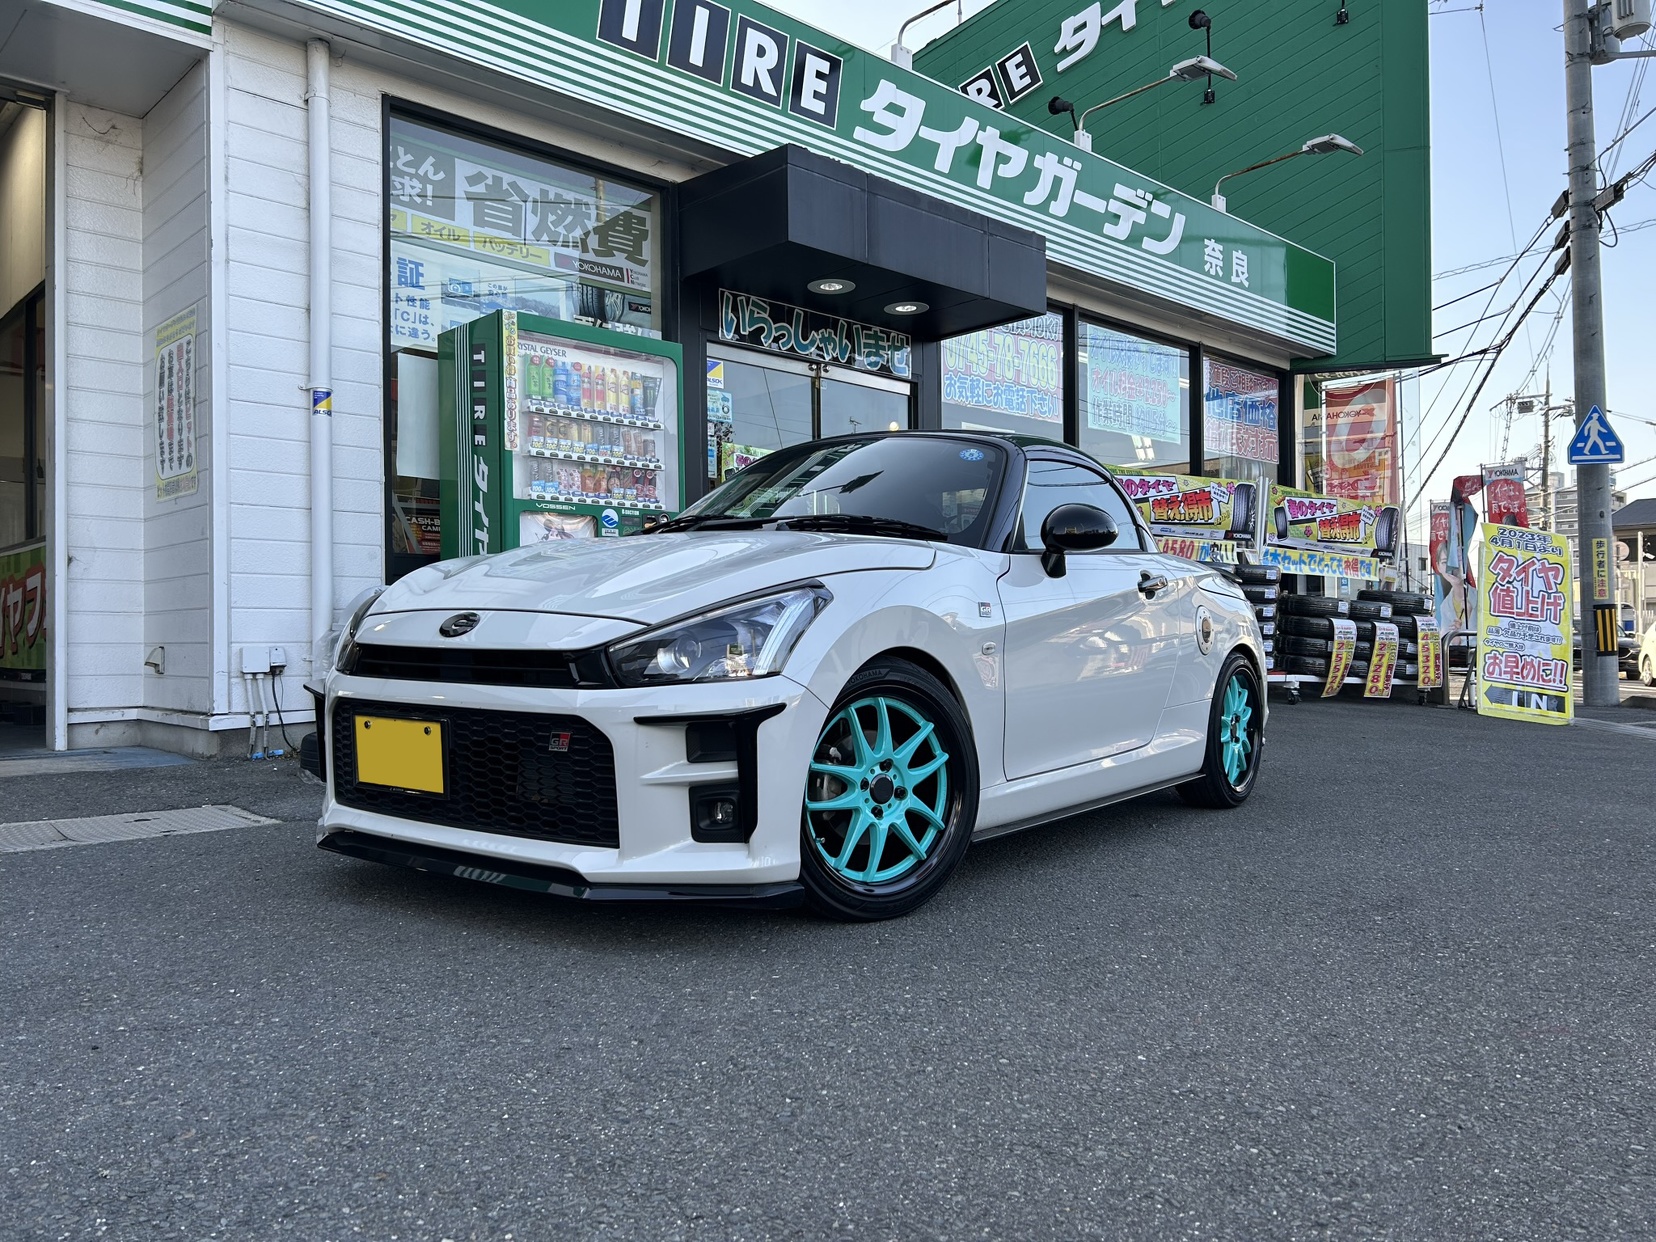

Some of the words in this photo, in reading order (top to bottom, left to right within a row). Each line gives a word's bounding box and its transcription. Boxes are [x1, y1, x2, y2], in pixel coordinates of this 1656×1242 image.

[390, 145, 446, 181] とん
[853, 79, 1186, 255] タイヤガーデン
[1203, 238, 1249, 287] 奈良
[464, 170, 650, 268] 省燃費
[420, 221, 461, 242] オイル
[482, 237, 543, 260] バッテリー
[396, 257, 425, 291] 証
[572, 260, 622, 278] YOKOHAMA
[391, 325, 436, 342] に違う。
[541, 345, 567, 358] GEYSER
[722, 290, 911, 376] いらっしゃいませ
[473, 350, 486, 447] TIRE
[944, 373, 1058, 418] お気軽にお電話下さい
[1205, 386, 1277, 431] 他店価格
[1204, 417, 1279, 462] 徹底対抗
[474, 454, 489, 556] タイヤ
[536, 502, 576, 511] VOSSEN
[1152, 489, 1214, 522] 替え得市
[1286, 498, 1337, 519] 春のタイヤ
[1318, 512, 1361, 541] 替え得市
[1498, 526, 1553, 544] 2023年
[1489, 537, 1564, 557] 4月1日より
[1489, 553, 1565, 592] タイヤ
[1595, 539, 1607, 598] 歩行者に注意
[1490, 584, 1565, 625] 値上げ
[1369, 641, 1387, 695] 27280
[1420, 633, 1431, 686] 45320
[1484, 651, 1567, 685] お早めに!!
[551, 737, 569, 746] GR
